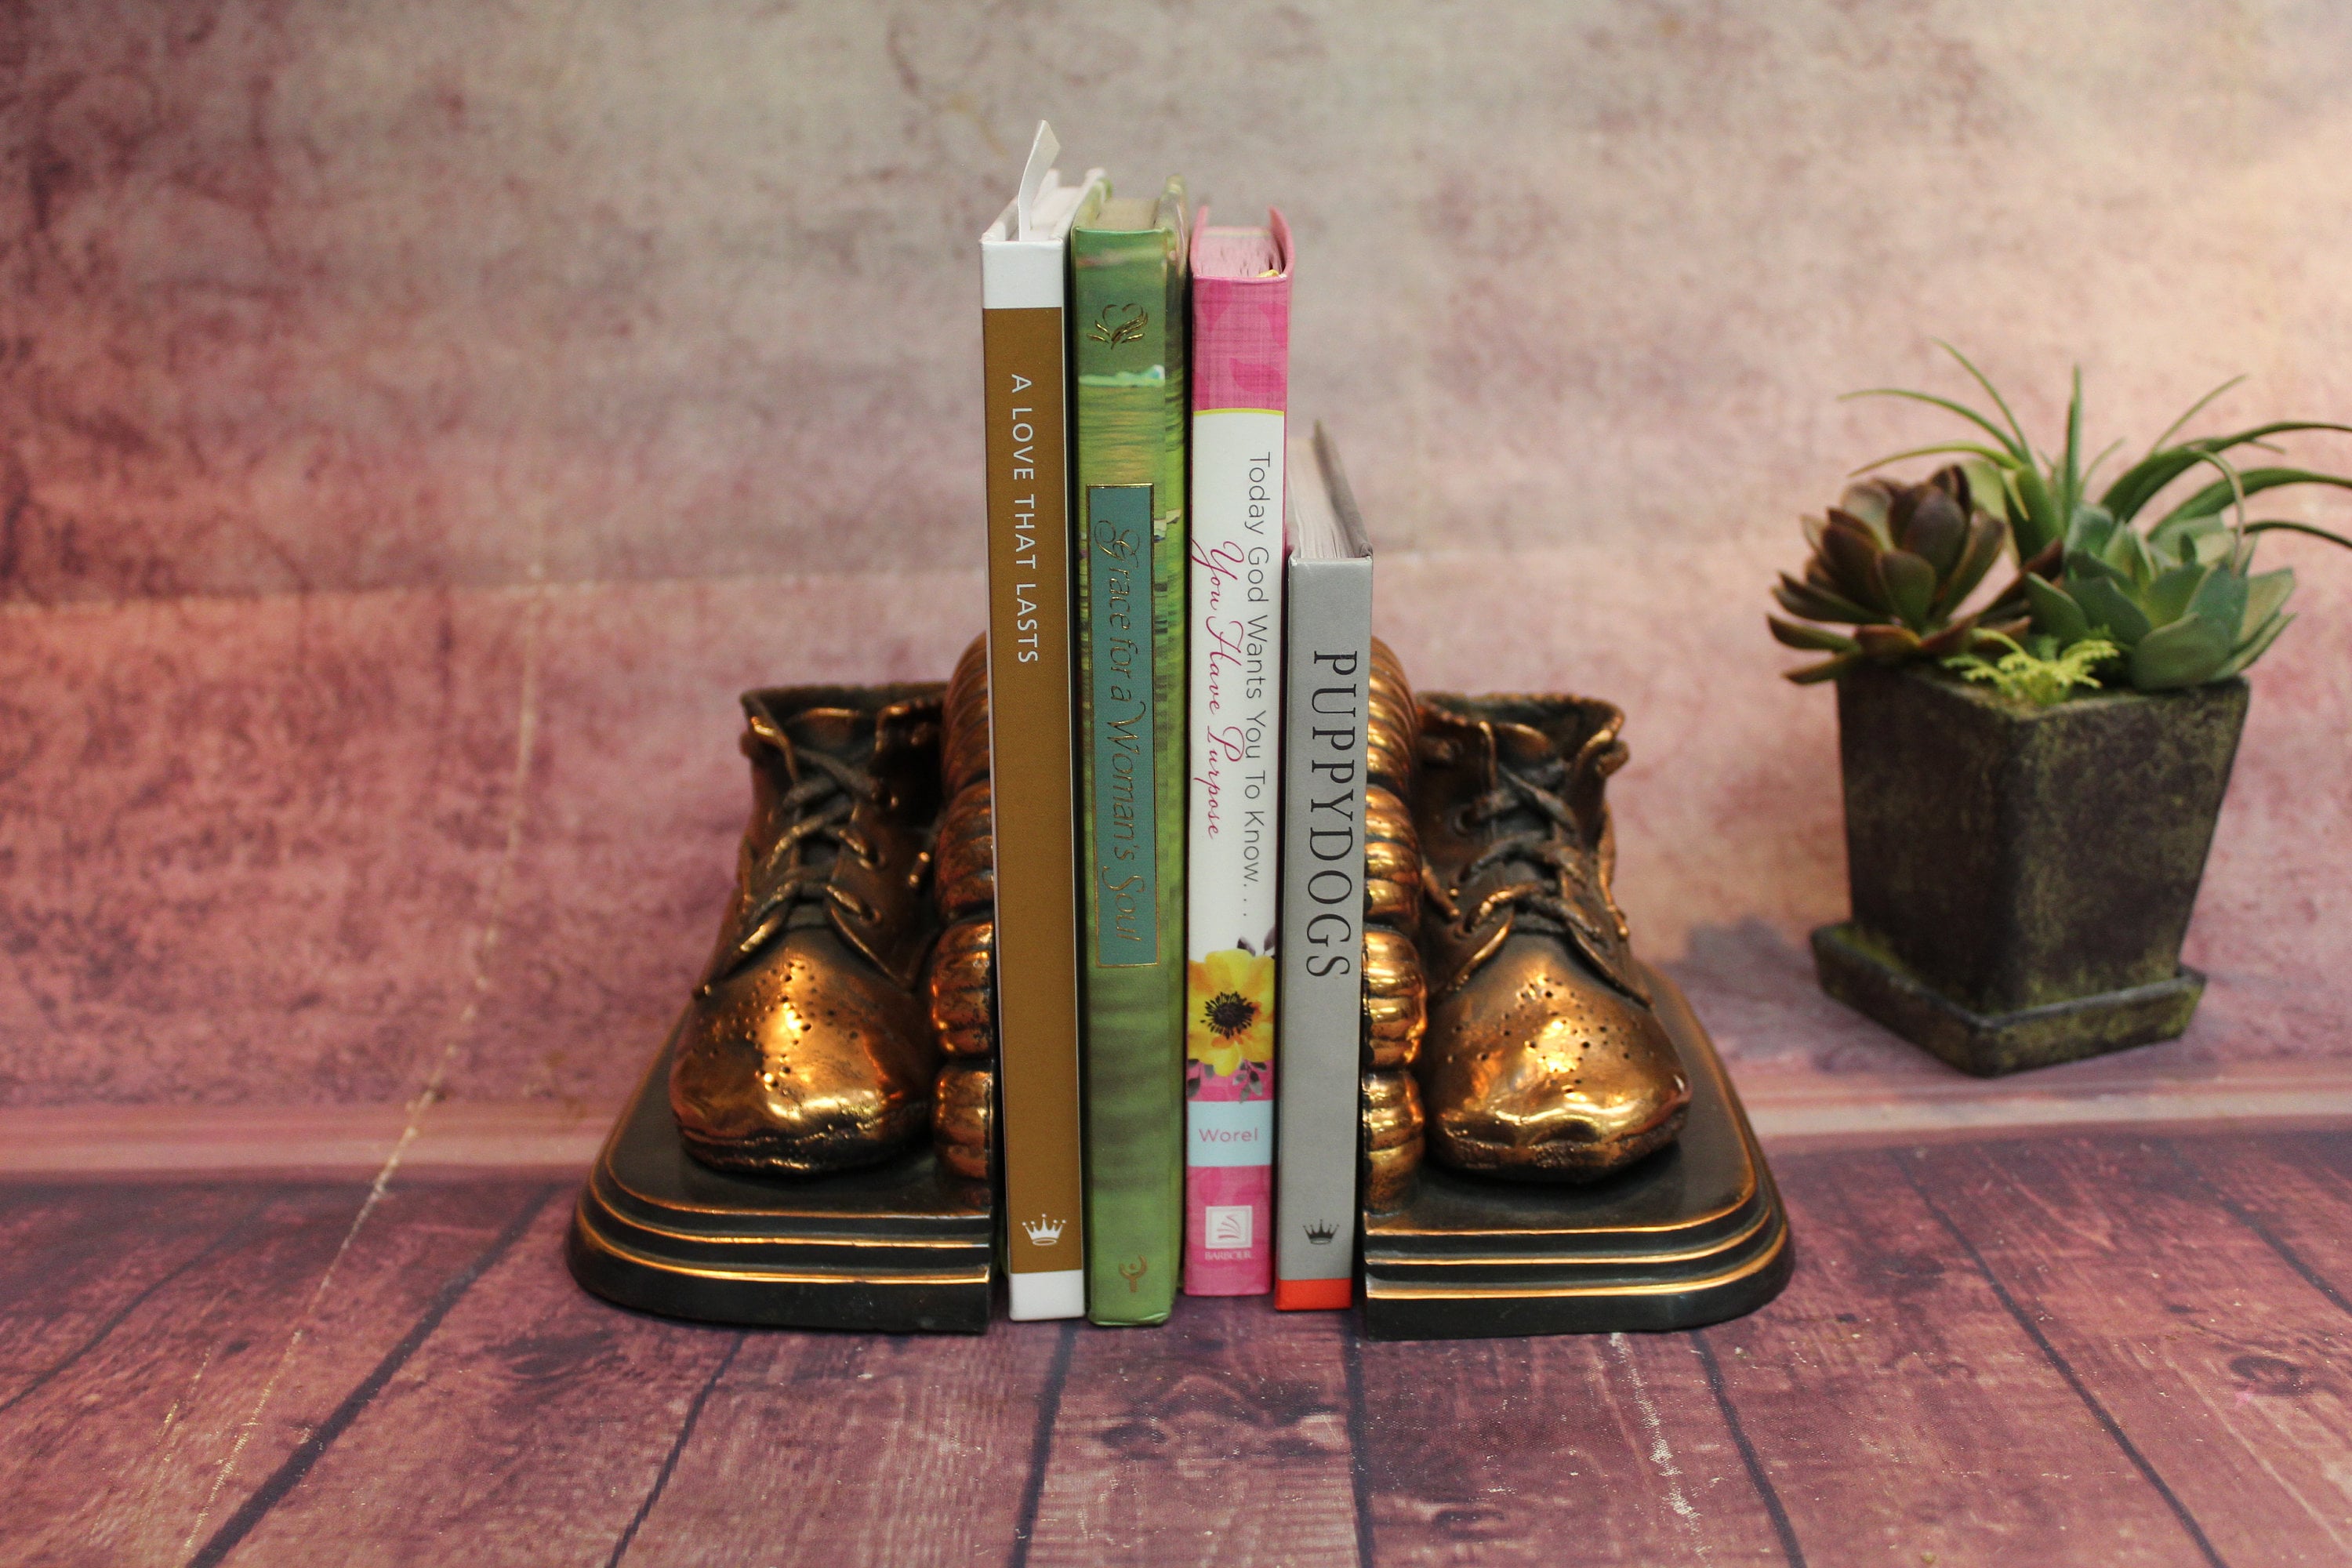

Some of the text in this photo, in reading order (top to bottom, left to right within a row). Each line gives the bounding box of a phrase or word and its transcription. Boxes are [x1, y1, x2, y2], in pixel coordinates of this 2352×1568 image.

[1011, 374, 1039, 663] A LOVE THAT LASTS
[1245, 451, 1271, 535] Today
[1247, 546, 1269, 602] God
[1192, 539, 1245, 840] You Have Purpose
[1246, 614, 1269, 699] Wants
[1094, 519, 1146, 942] Grace for a Woman's Soul
[1245, 710, 1266, 759] You
[1244, 770, 1265, 800] To
[1305, 650, 1358, 978] PUPPYDOGS
[1199, 1127, 1258, 1142] Worel
